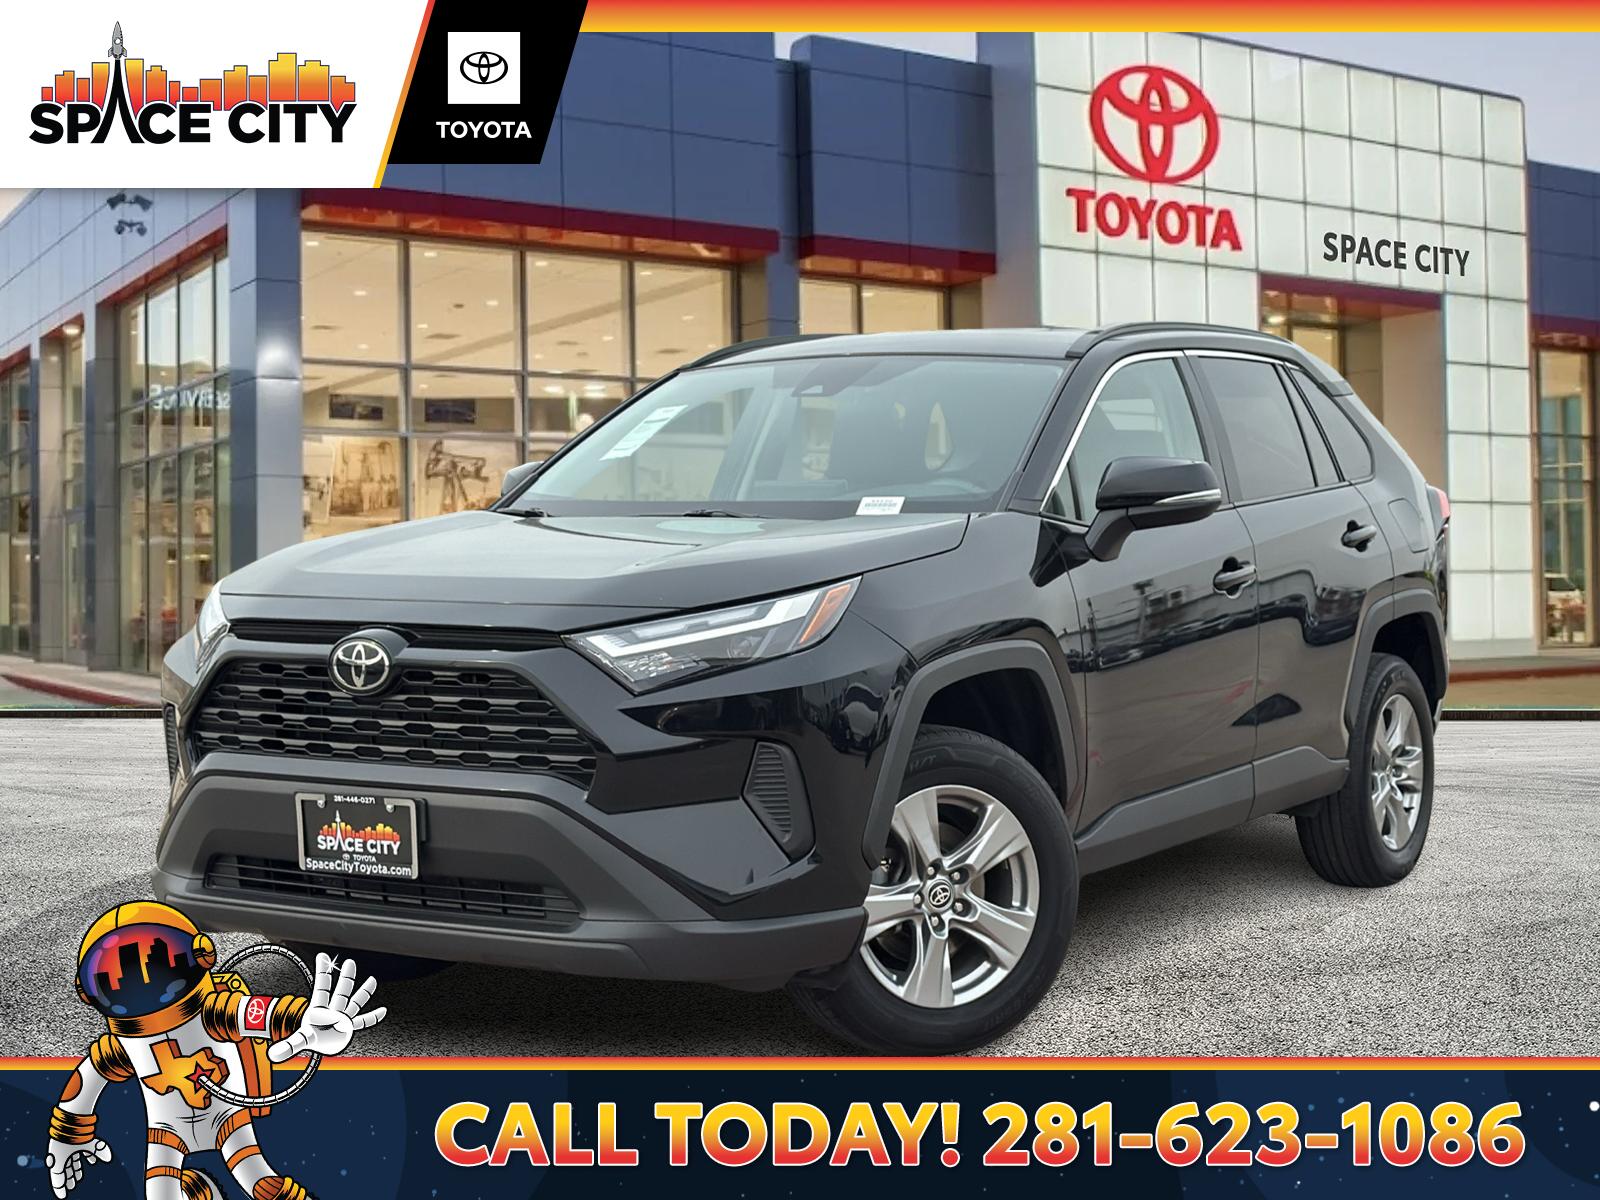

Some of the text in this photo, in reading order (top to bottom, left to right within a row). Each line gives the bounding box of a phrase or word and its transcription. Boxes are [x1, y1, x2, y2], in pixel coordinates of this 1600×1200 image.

[1066, 187, 1243, 252] TOYOTA
[1322, 231, 1471, 277] SPACE CITY
[317, 835, 400, 855] SPACE CITY
[306, 858, 411, 876] SpaceCityToyota.com
[352, 853, 377, 863] TOYOTA
